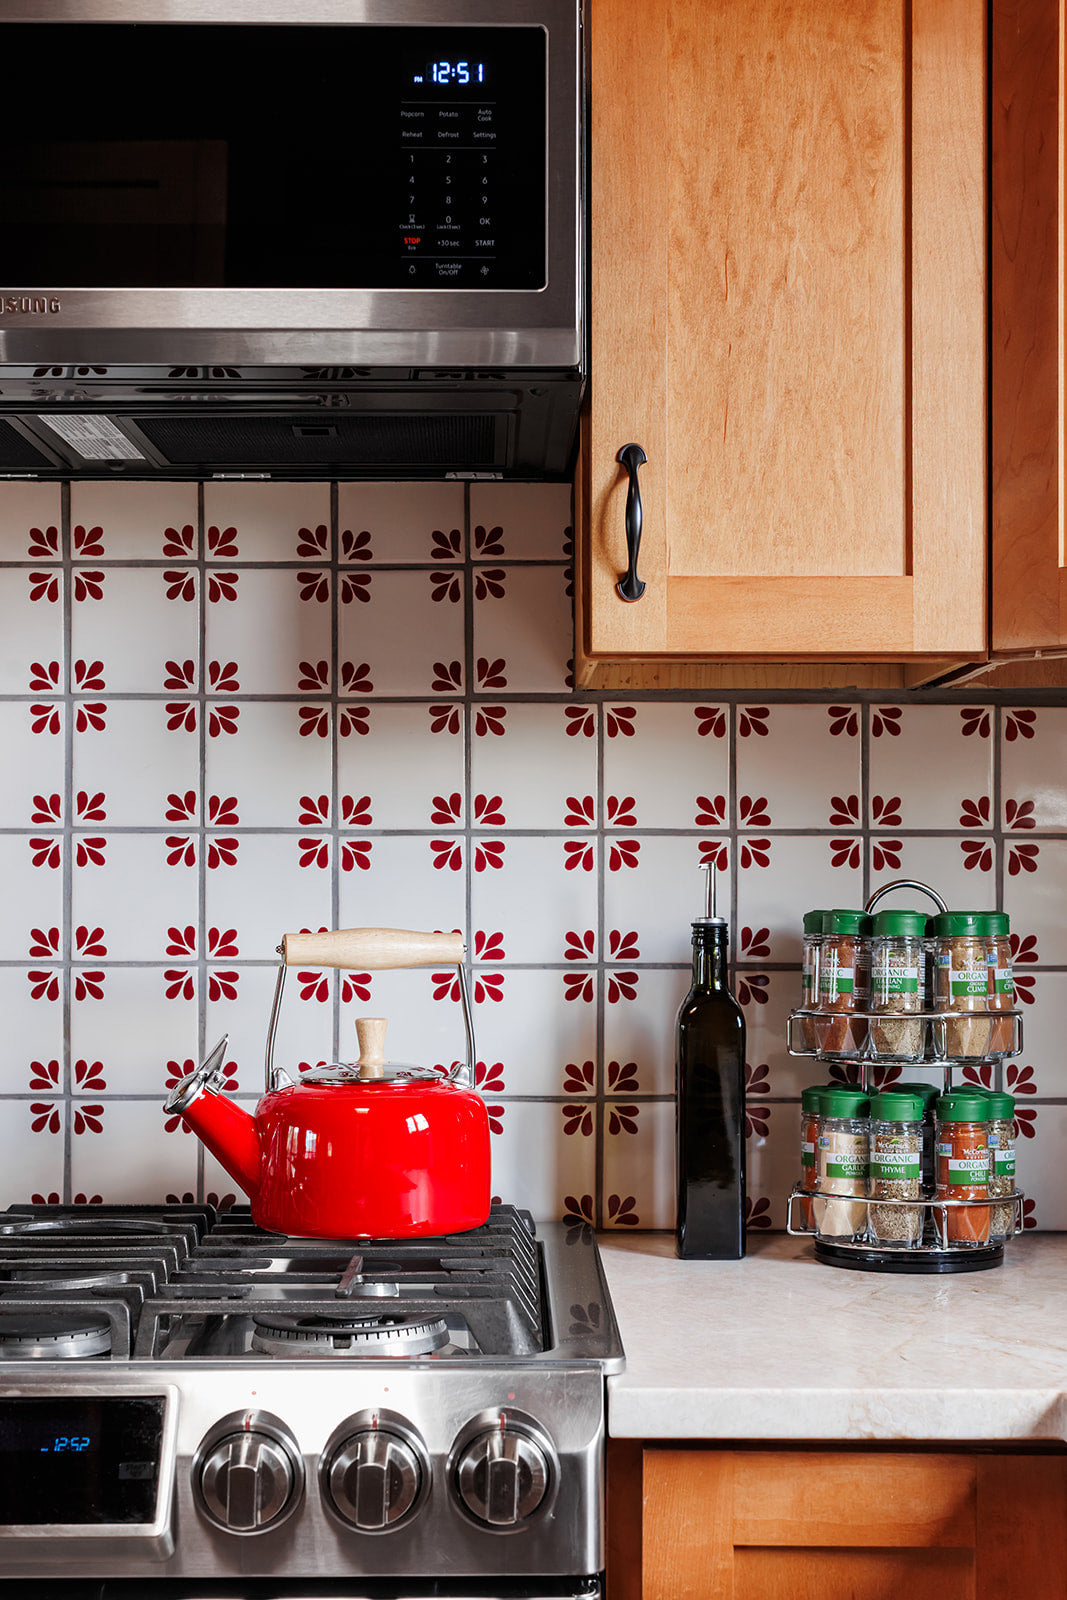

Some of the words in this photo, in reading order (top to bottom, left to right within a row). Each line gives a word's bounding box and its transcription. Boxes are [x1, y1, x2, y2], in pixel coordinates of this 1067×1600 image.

[432, 61, 483, 83] 12:51
[400, 110, 425, 119] Popcorn
[472, 131, 497, 139] Settings
[410, 154, 414, 163] 1
[446, 154, 451, 163] 2
[482, 155, 488, 164] 3
[446, 176, 451, 184] 5
[482, 176, 488, 184] 6
[409, 195, 415, 204] 7
[446, 195, 451, 204] 8
[482, 196, 488, 204] 9
[446, 215, 452, 224] 0
[479, 217, 491, 225] OK
[957, 972, 987, 980] ORGAN
[835, 1154, 865, 1163] ORGAN
[874, 1153, 914, 1163] ORGANIC
[958, 1160, 988, 1170] ORGAN
[880, 1166, 906, 1174] THYME
[54, 1437, 90, 1451] 12:52
